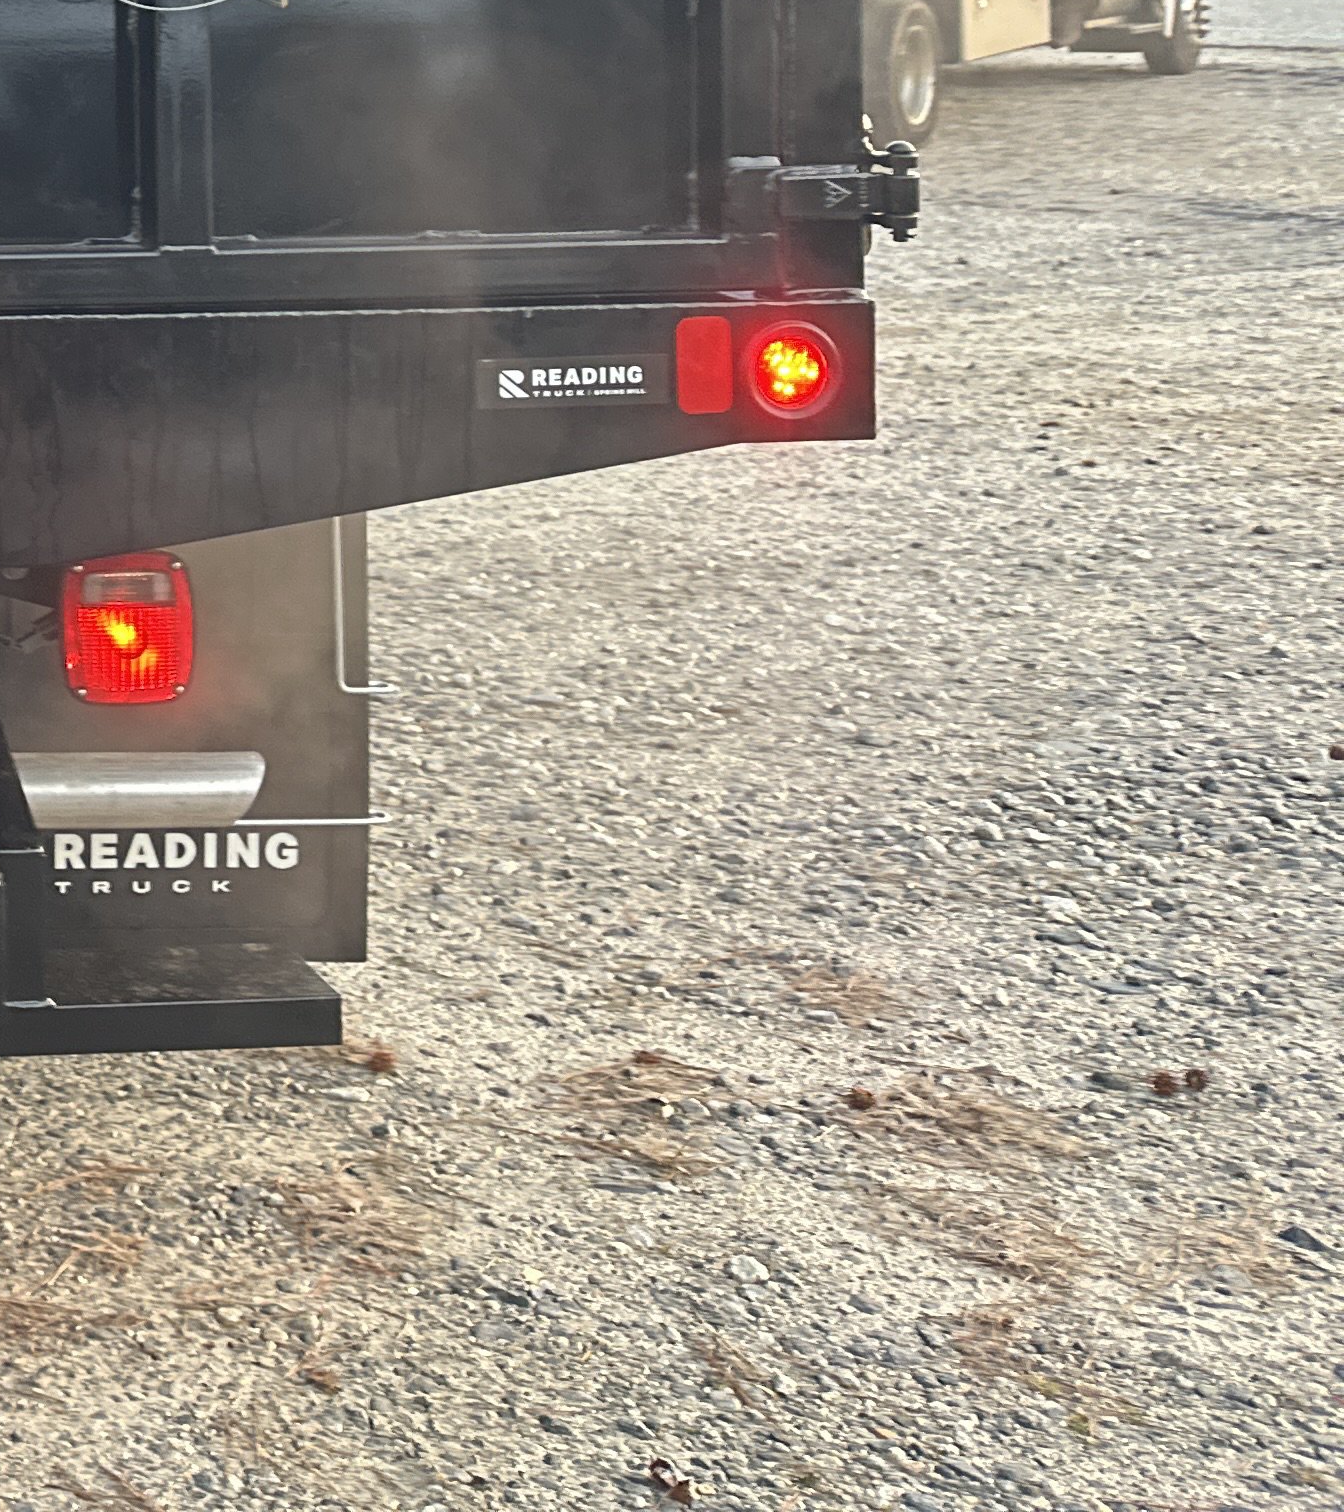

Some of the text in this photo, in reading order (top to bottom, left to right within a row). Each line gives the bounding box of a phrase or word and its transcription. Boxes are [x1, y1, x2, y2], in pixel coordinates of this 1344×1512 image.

[532, 366, 643, 386] READING
[532, 388, 585, 398] TRUCK
[53, 832, 300, 870] READING
[54, 880, 232, 894] TRUCK
